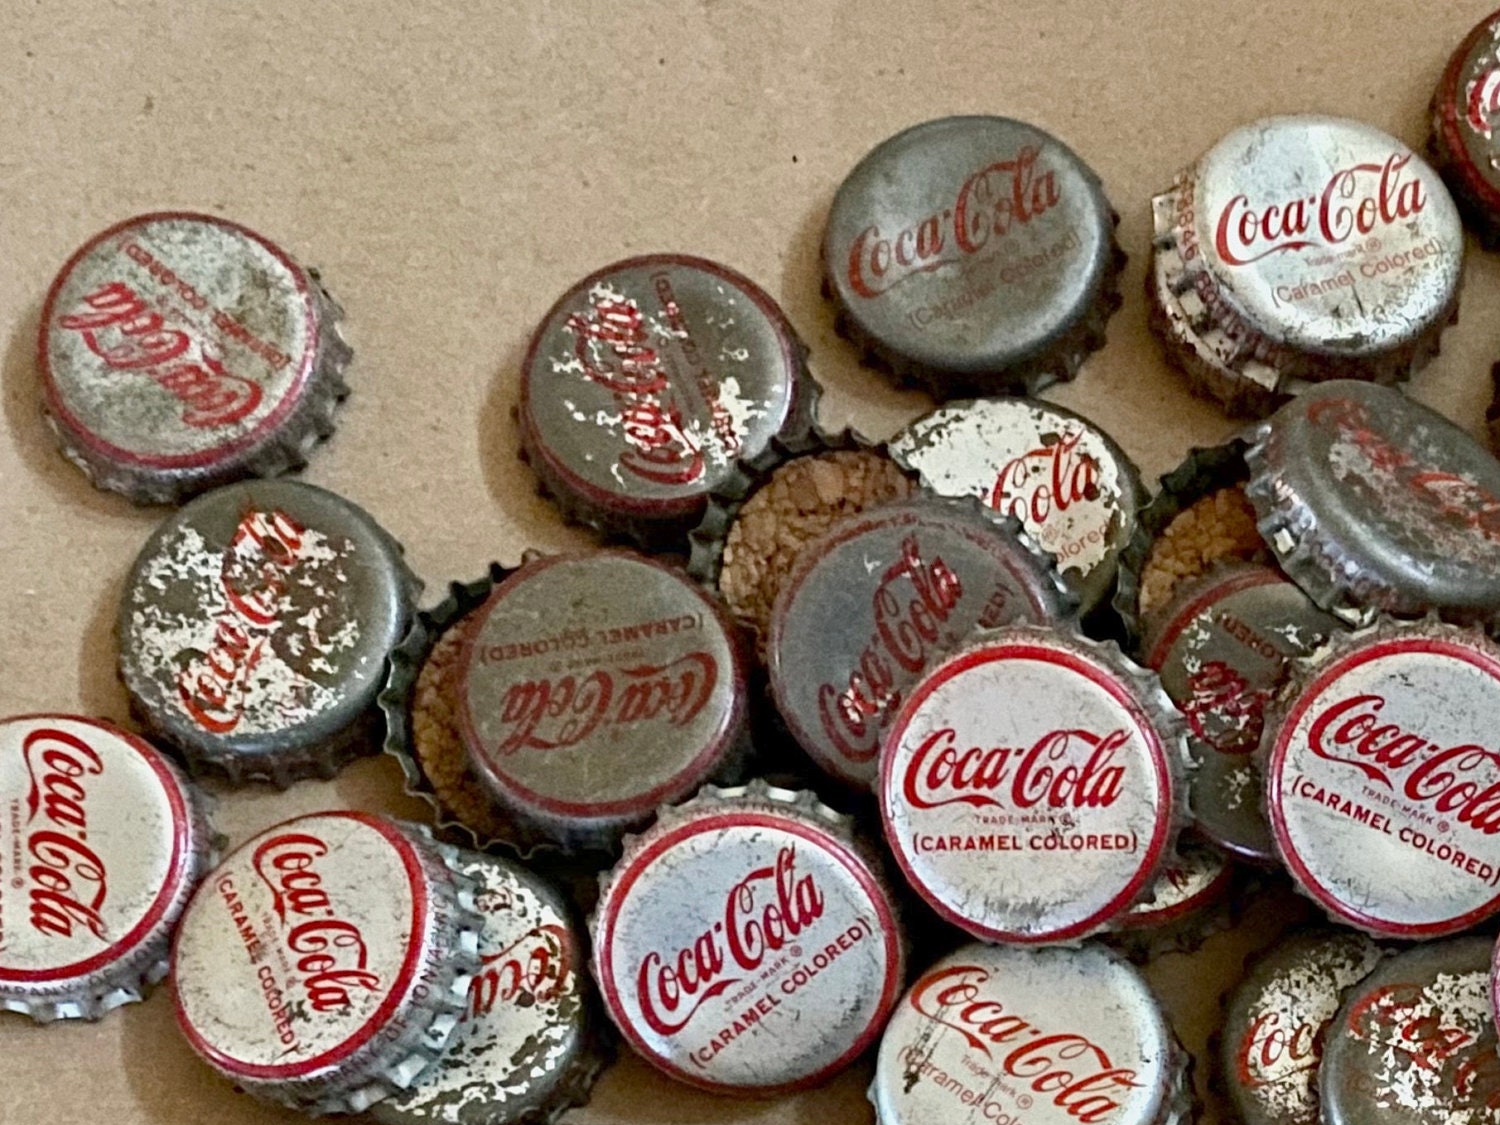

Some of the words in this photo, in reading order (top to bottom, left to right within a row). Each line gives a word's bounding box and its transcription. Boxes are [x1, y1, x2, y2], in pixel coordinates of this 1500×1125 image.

[1291, 774, 1392, 836] (CARAMEL
[913, 831, 1022, 855] (CARAMEL
[690, 994, 781, 1068] (CARAMEL
[781, 917, 873, 997] COLORED)
